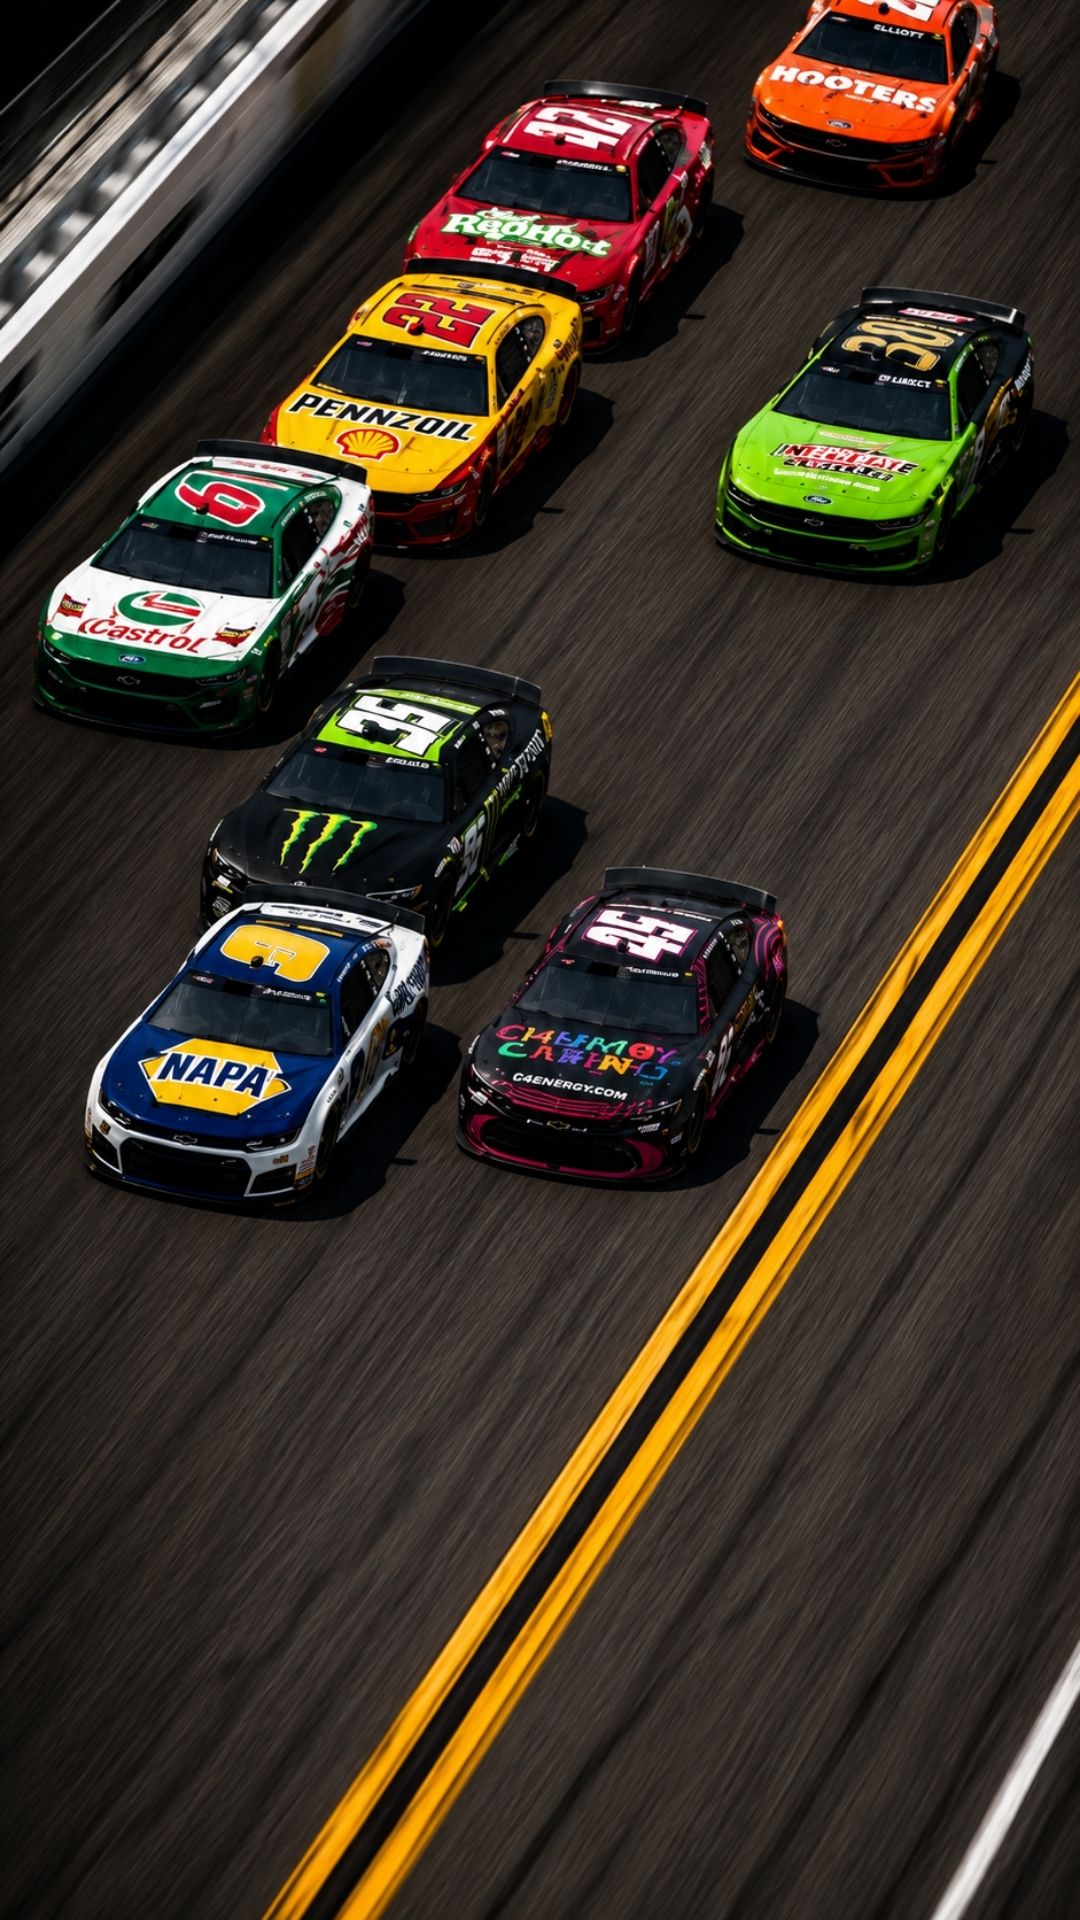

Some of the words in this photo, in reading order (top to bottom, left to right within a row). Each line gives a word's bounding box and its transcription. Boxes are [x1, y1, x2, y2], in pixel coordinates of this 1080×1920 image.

[873, 23, 925, 40] ELLIOTT
[769, 65, 937, 113] HOOTERS
[382, 292, 496, 349] 22
[288, 393, 475, 441] PENNZOIL
[88, 618, 207, 654] Castrol
[157, 1052, 270, 1099] NAPA
[511, 1072, 629, 1102] C4ENERGY.COM
